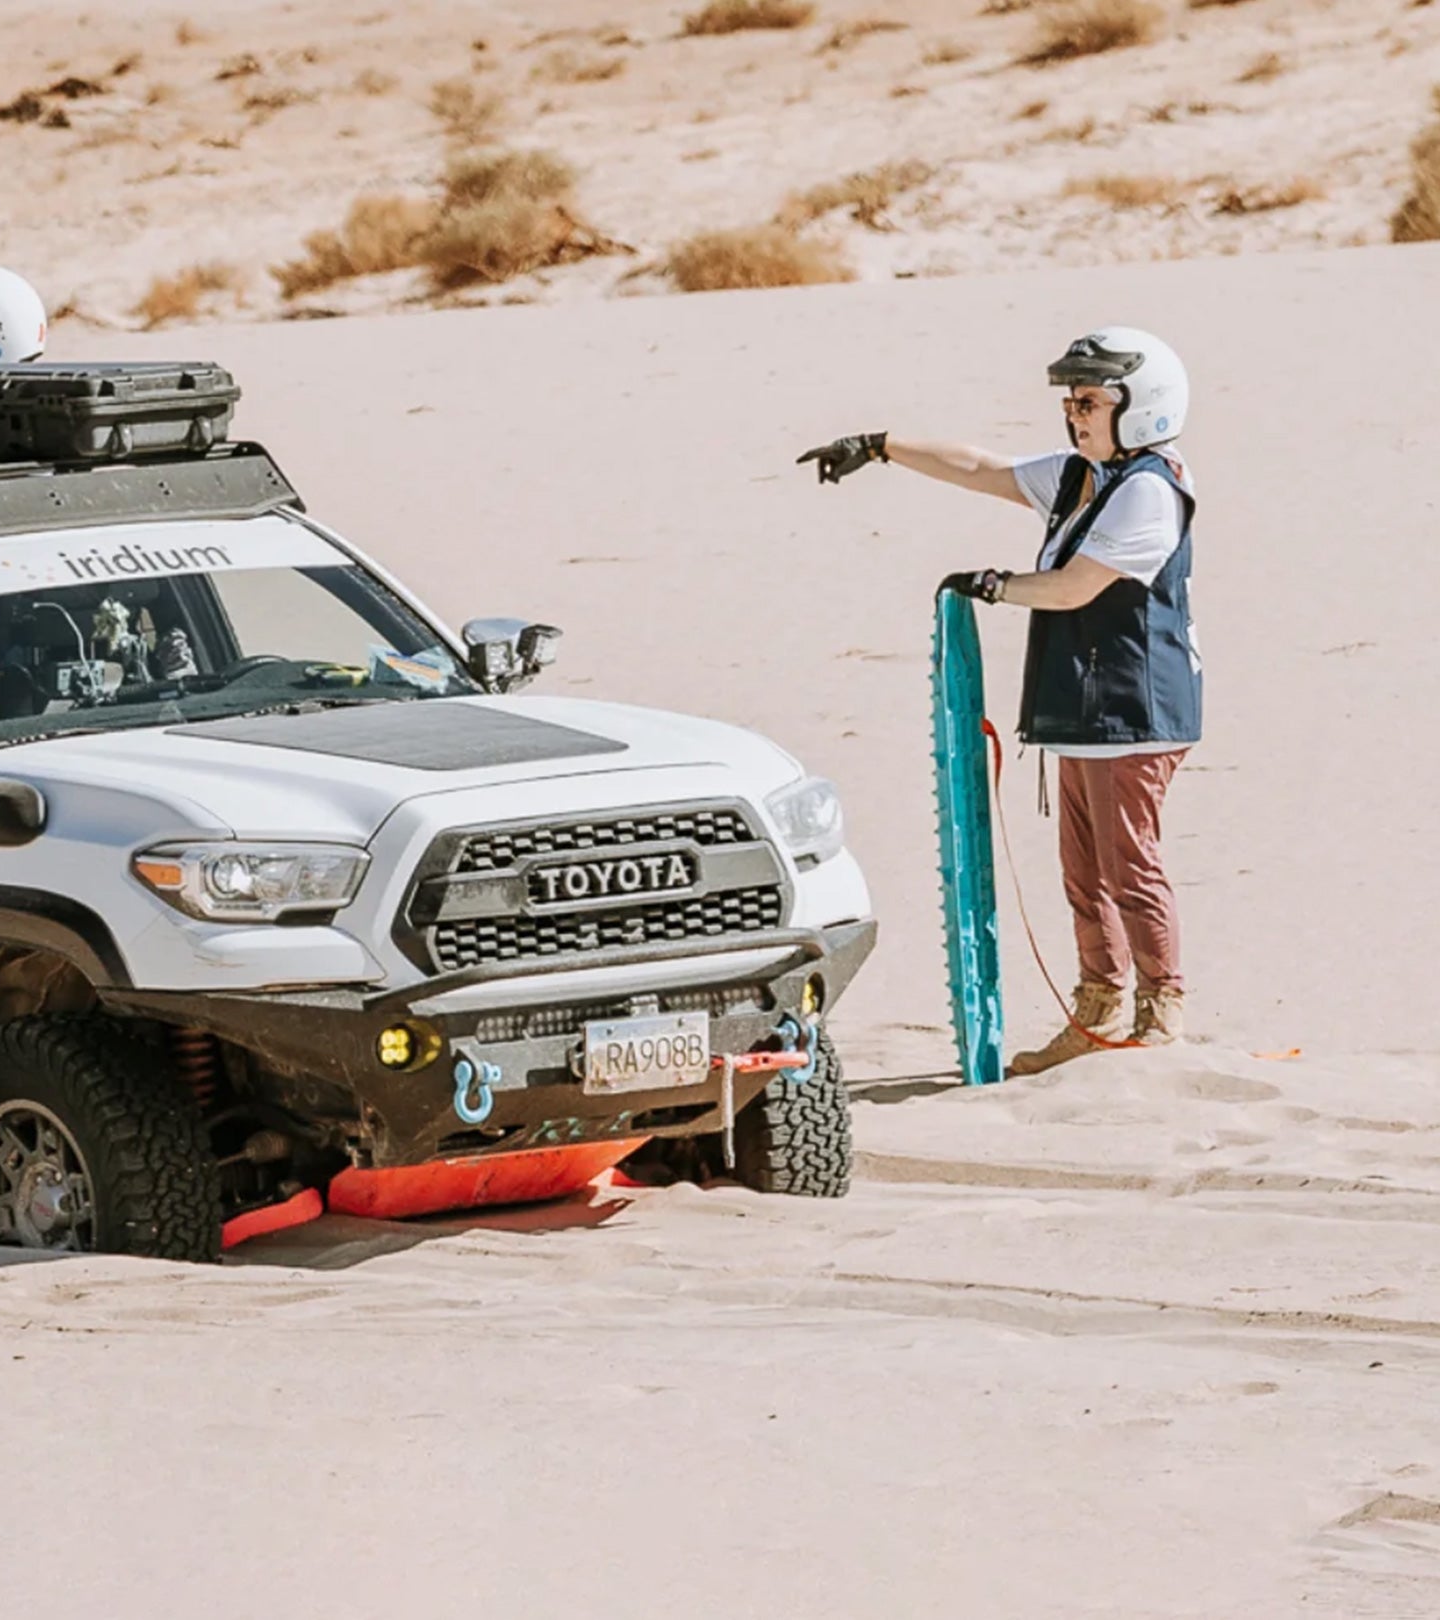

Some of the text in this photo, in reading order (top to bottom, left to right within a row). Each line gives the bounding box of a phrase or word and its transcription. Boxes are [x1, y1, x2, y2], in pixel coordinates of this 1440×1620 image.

[58, 544, 232, 579] iridium
[536, 854, 691, 900] TOYOTA
[606, 1033, 704, 1075] RA908B
